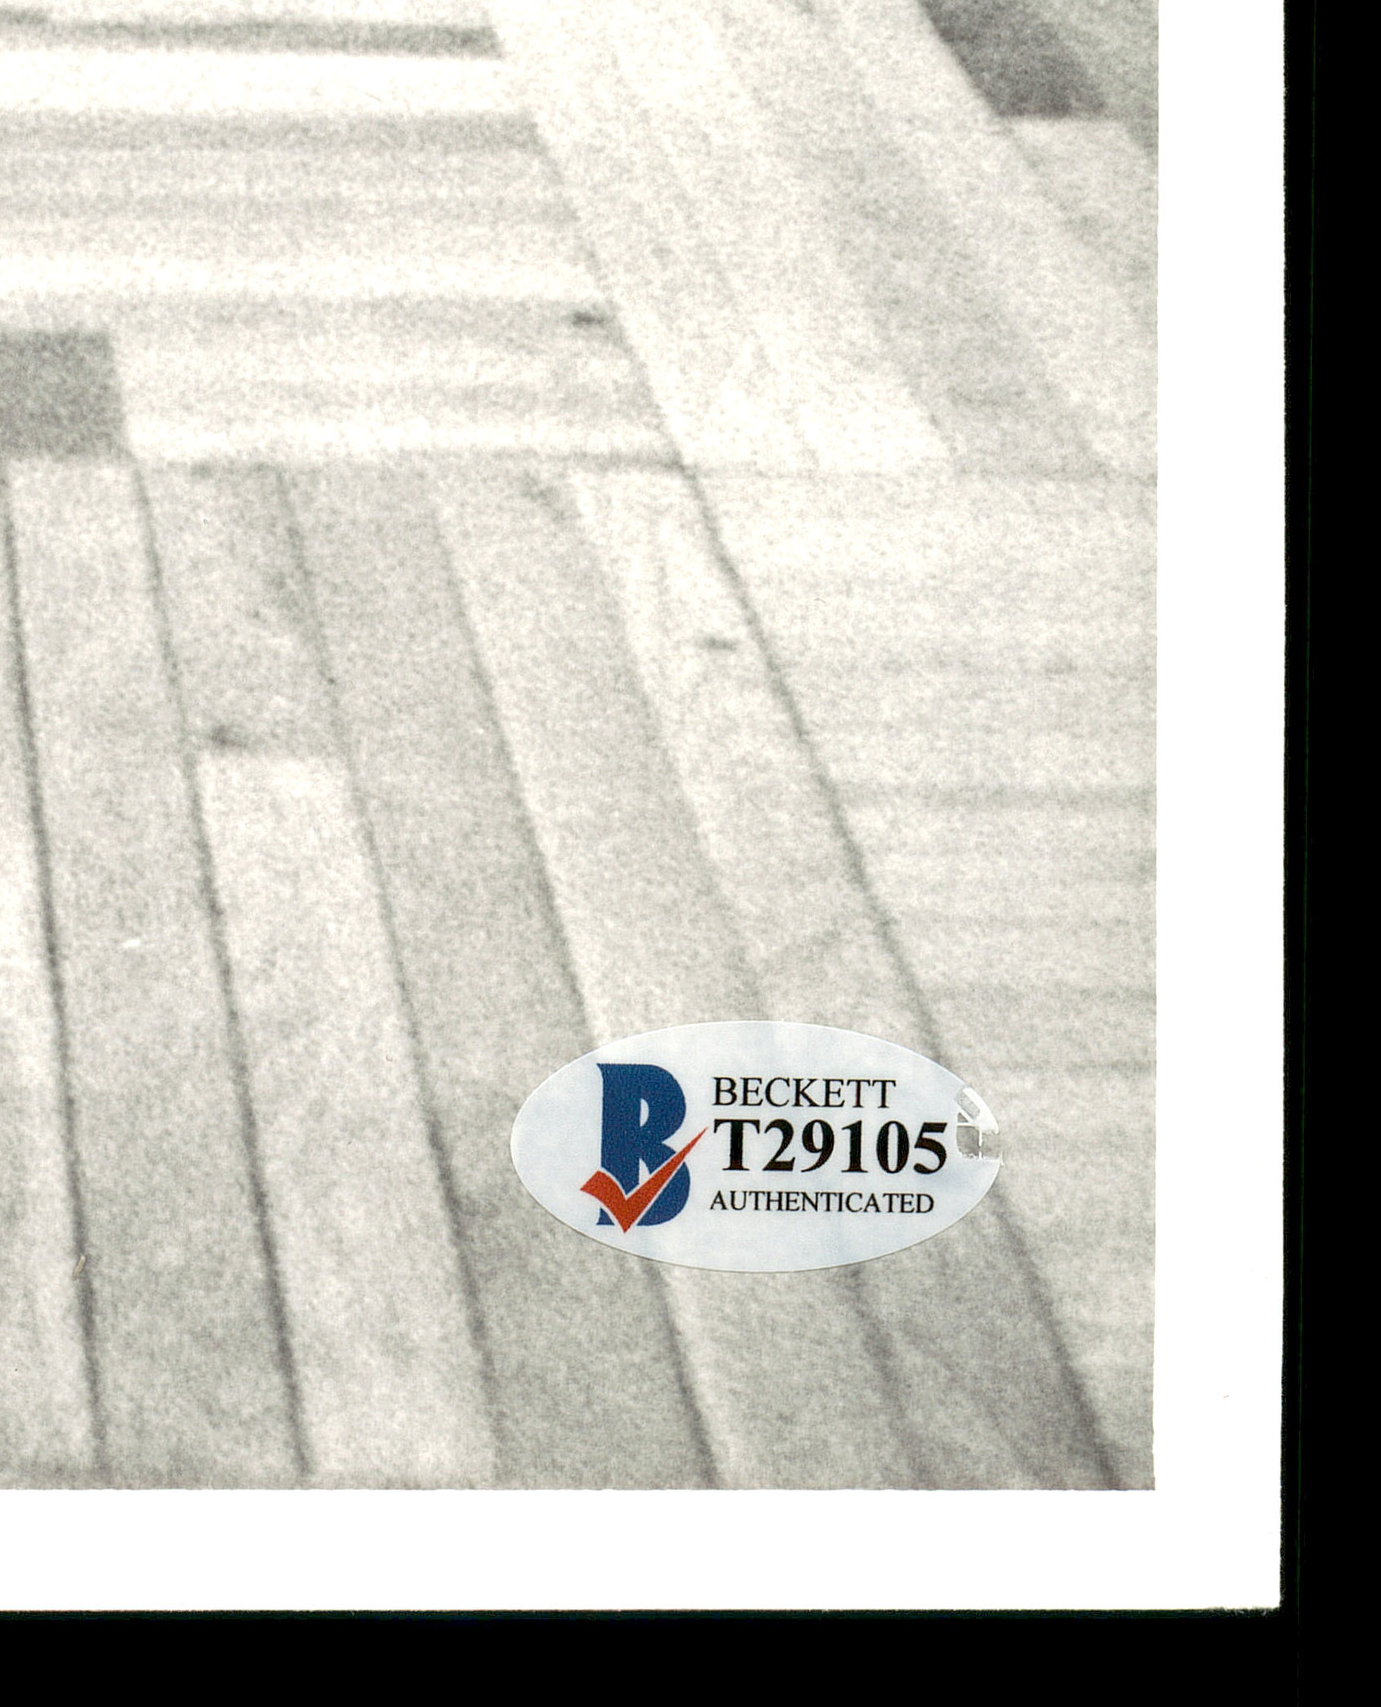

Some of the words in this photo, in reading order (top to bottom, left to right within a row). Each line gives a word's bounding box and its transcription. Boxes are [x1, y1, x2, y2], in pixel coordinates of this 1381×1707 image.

[712, 1076, 897, 1109] BECKETT
[713, 1118, 948, 1175] T29105
[710, 1190, 935, 1214] AUTHENTICATED
